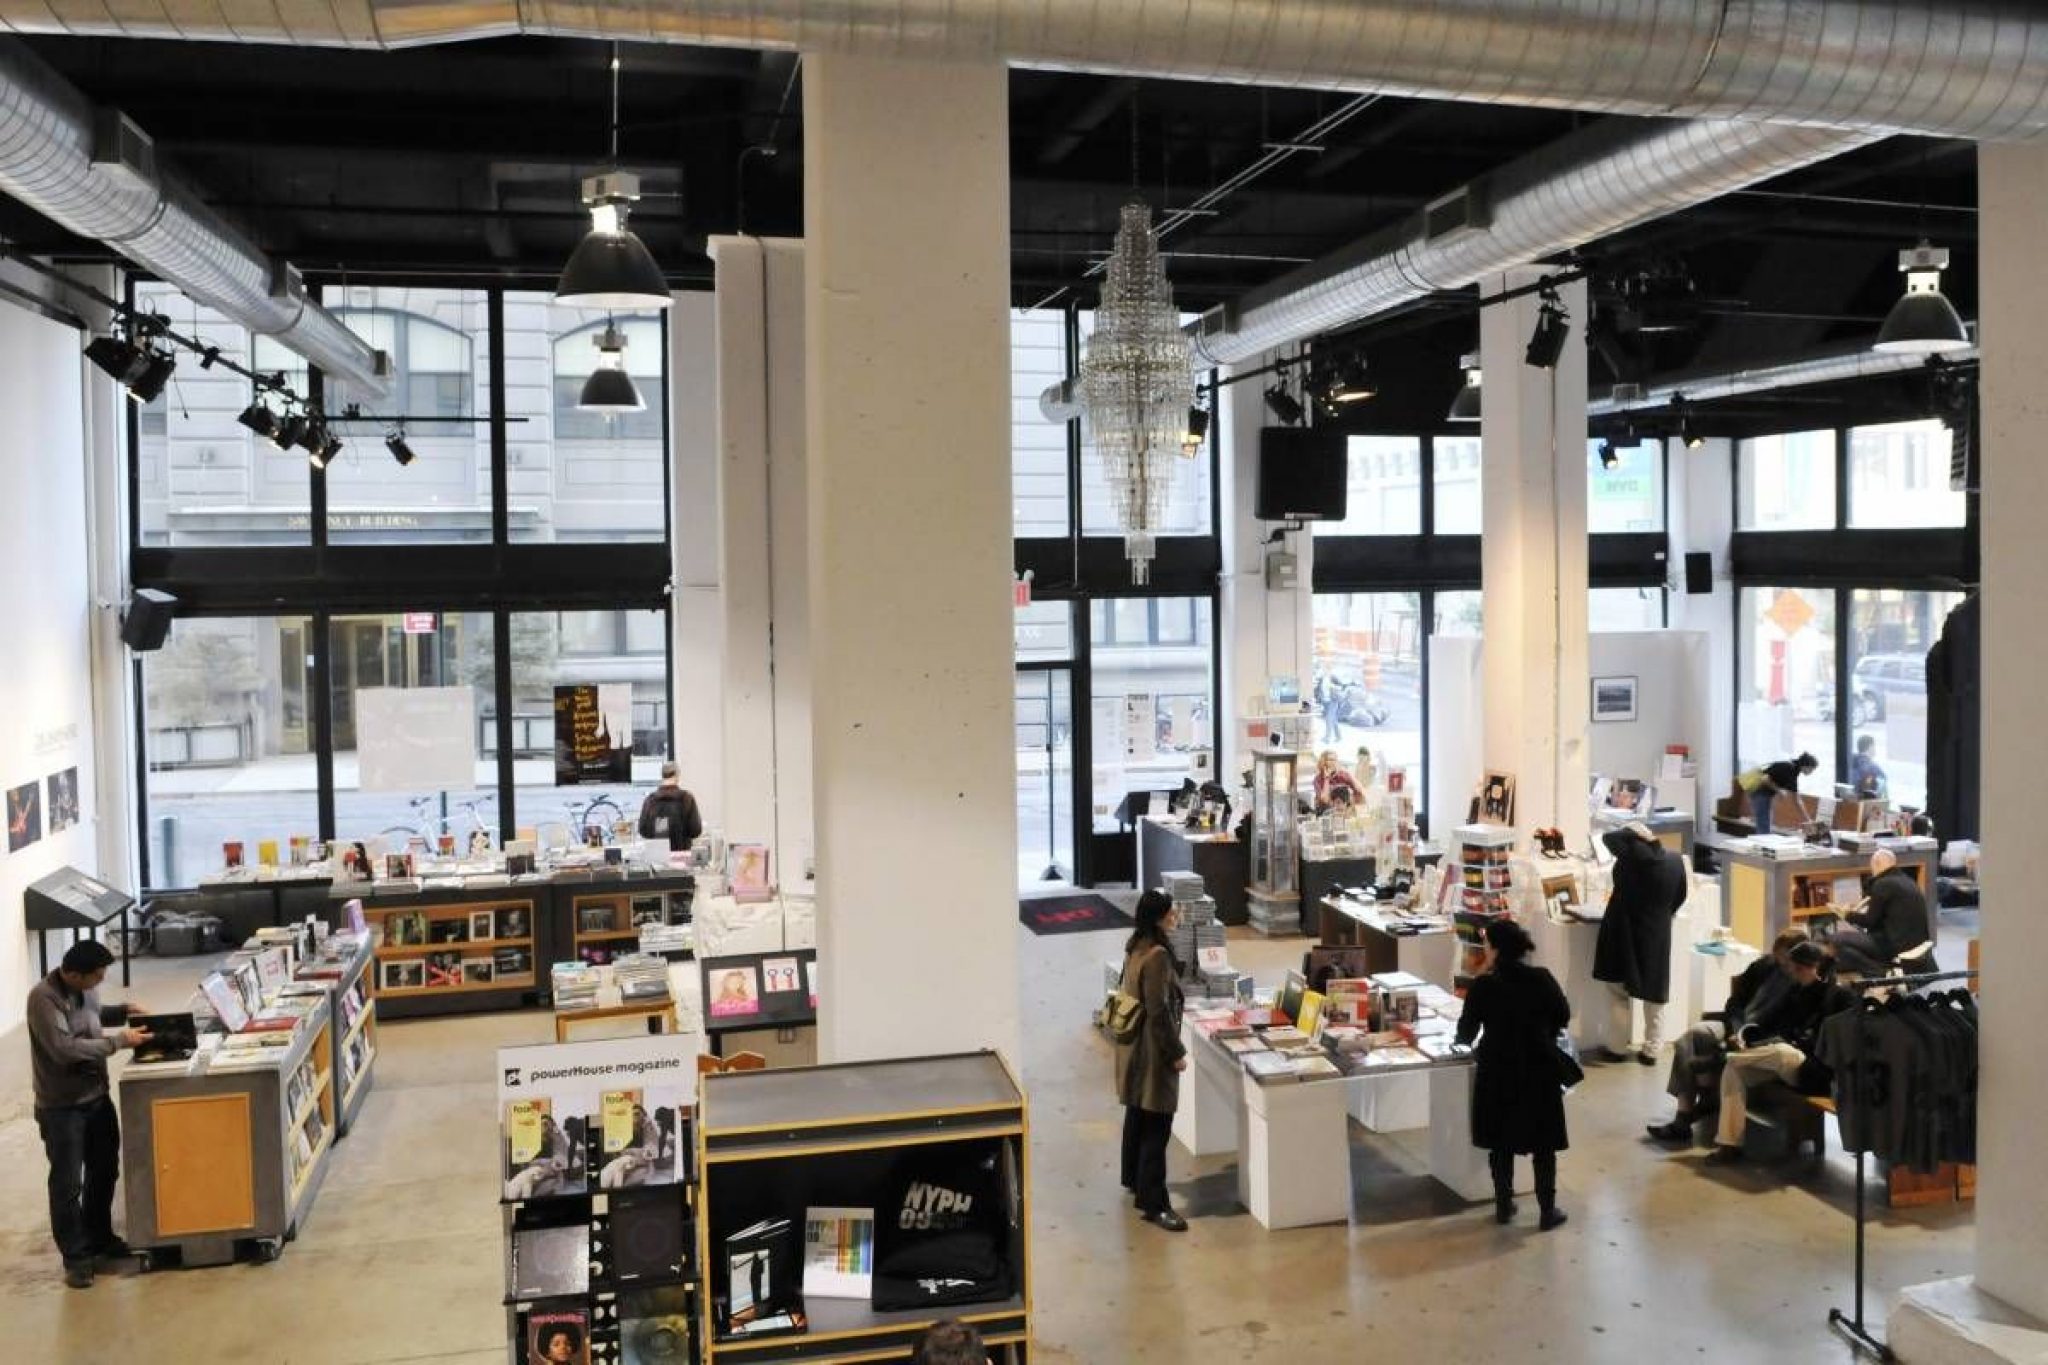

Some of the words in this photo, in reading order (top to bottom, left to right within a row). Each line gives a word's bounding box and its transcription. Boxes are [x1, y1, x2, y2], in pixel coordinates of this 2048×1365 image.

[530, 1065, 613, 1084] powerHouse
[615, 1057, 680, 1074] magazine
[903, 1182, 973, 1214] NYPH
